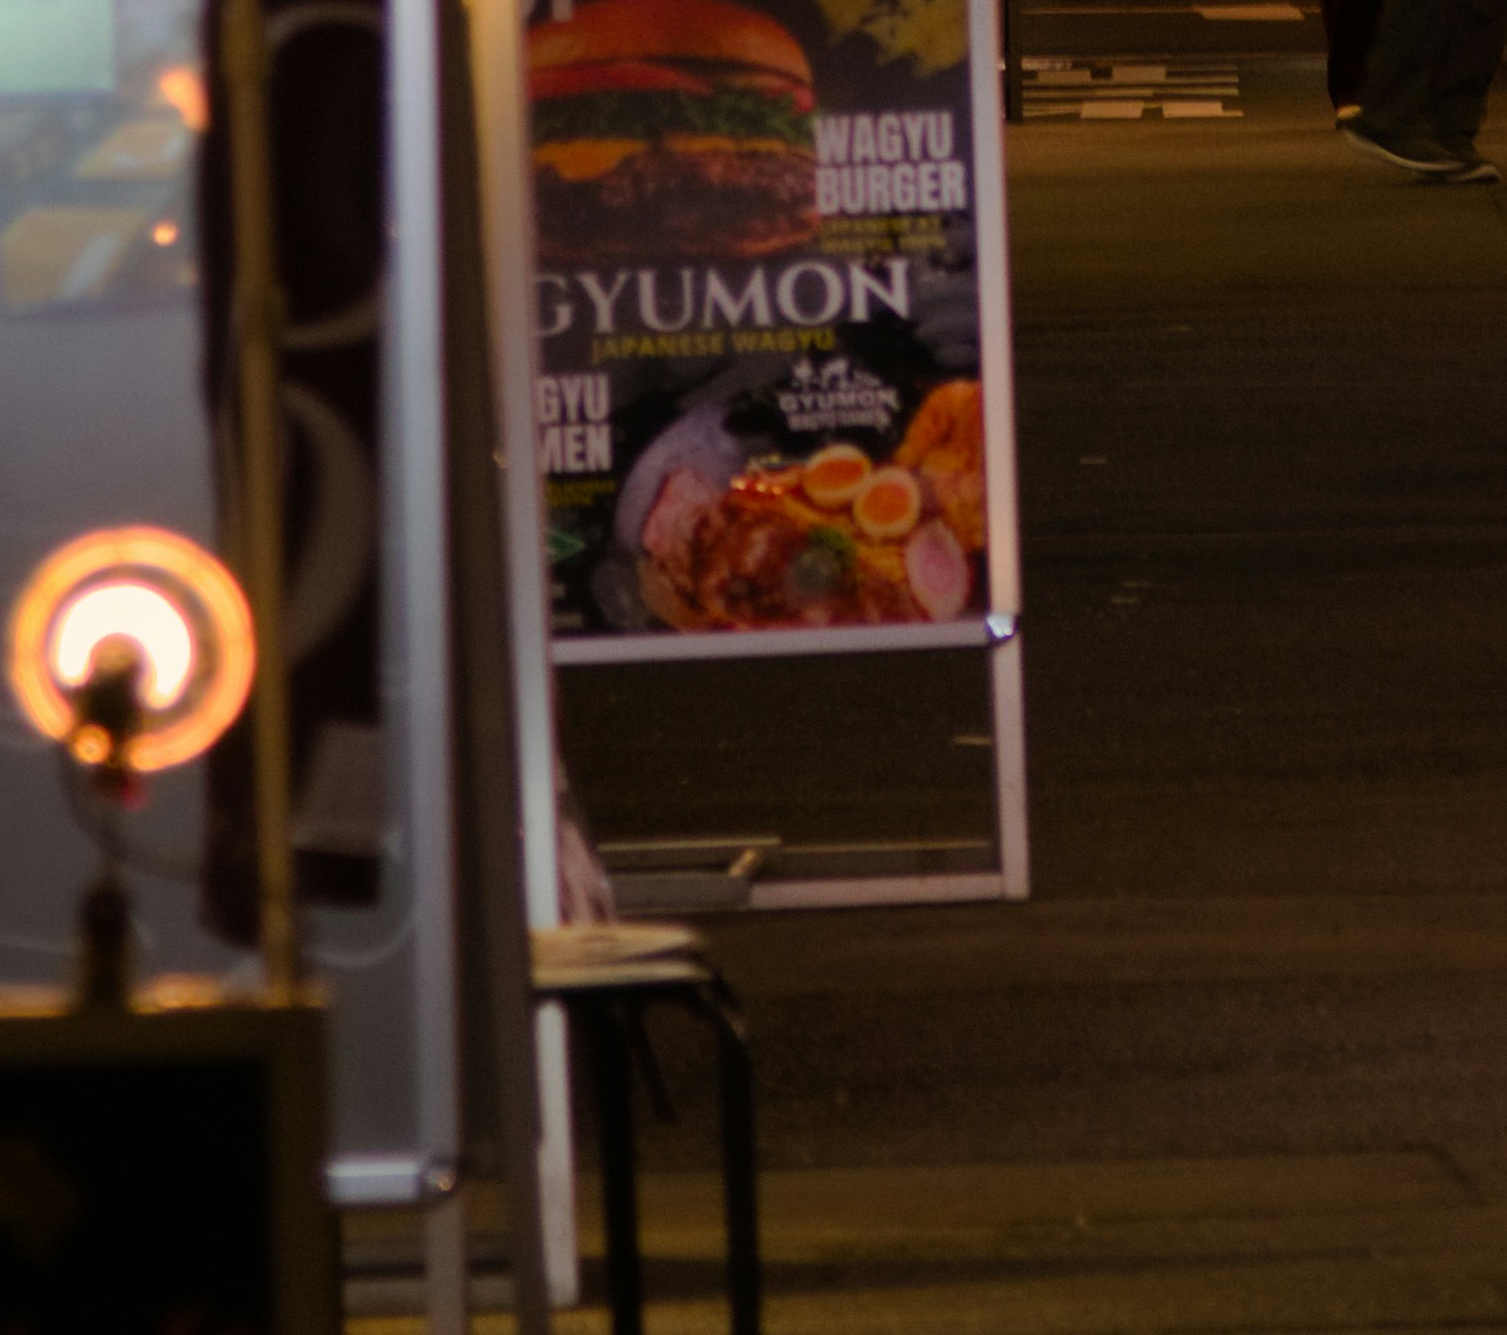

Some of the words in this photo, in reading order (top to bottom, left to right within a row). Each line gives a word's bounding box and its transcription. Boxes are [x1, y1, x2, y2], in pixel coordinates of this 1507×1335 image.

[813, 112, 954, 166] WAGYU
[816, 162, 967, 215] BURGER
[534, 257, 915, 336] GYUMON
[731, 329, 836, 355] WAGYU
